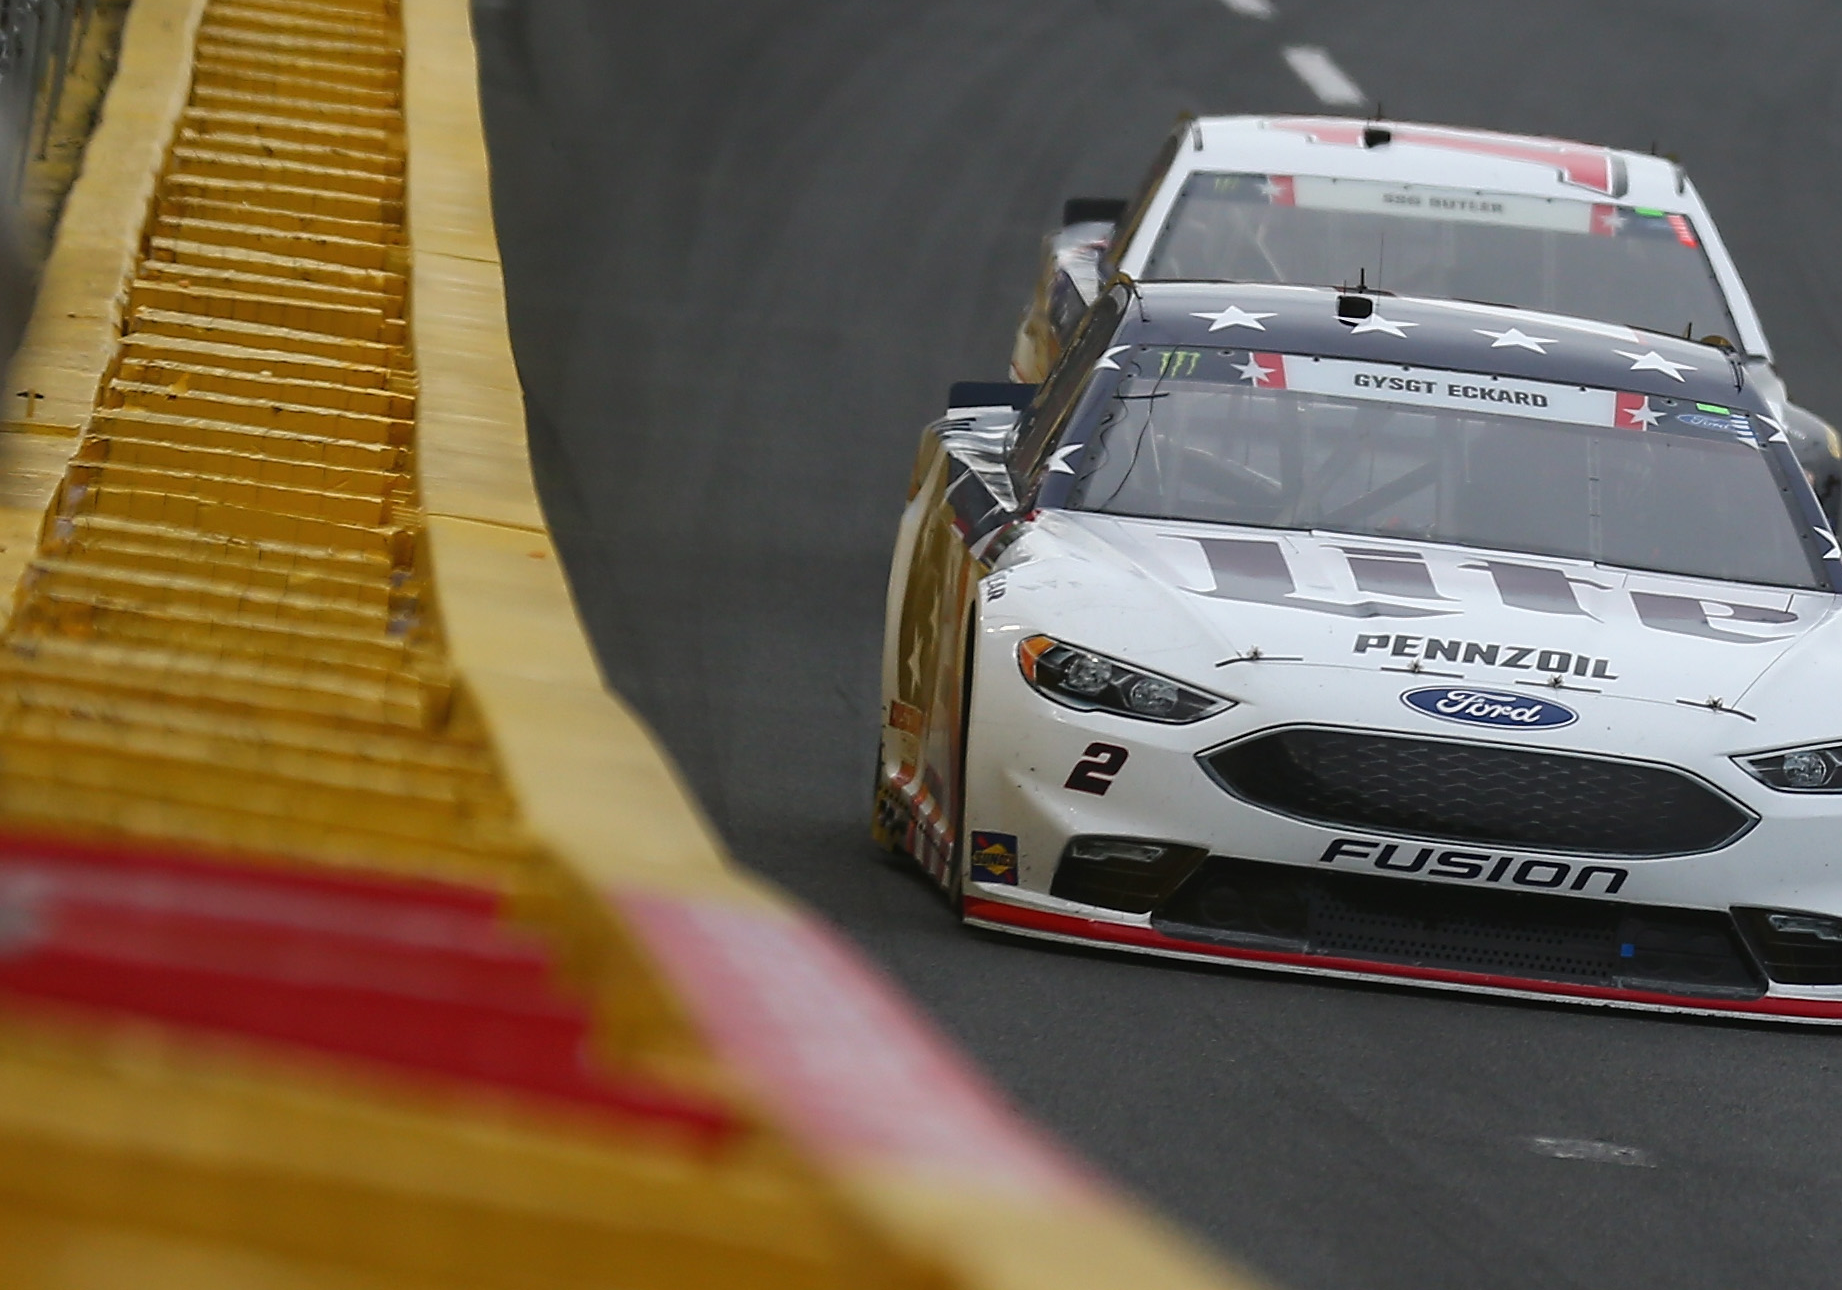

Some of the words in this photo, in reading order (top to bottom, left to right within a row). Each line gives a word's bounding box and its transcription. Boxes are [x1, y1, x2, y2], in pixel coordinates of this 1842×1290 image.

[1354, 373, 1438, 395] GYSGT
[1447, 384, 1549, 409] ECKARD
[1353, 633, 1620, 680] PENNZOIL
[1438, 690, 1543, 723] Ford
[1063, 741, 1131, 797] 2
[1319, 838, 1630, 895] FUSION
